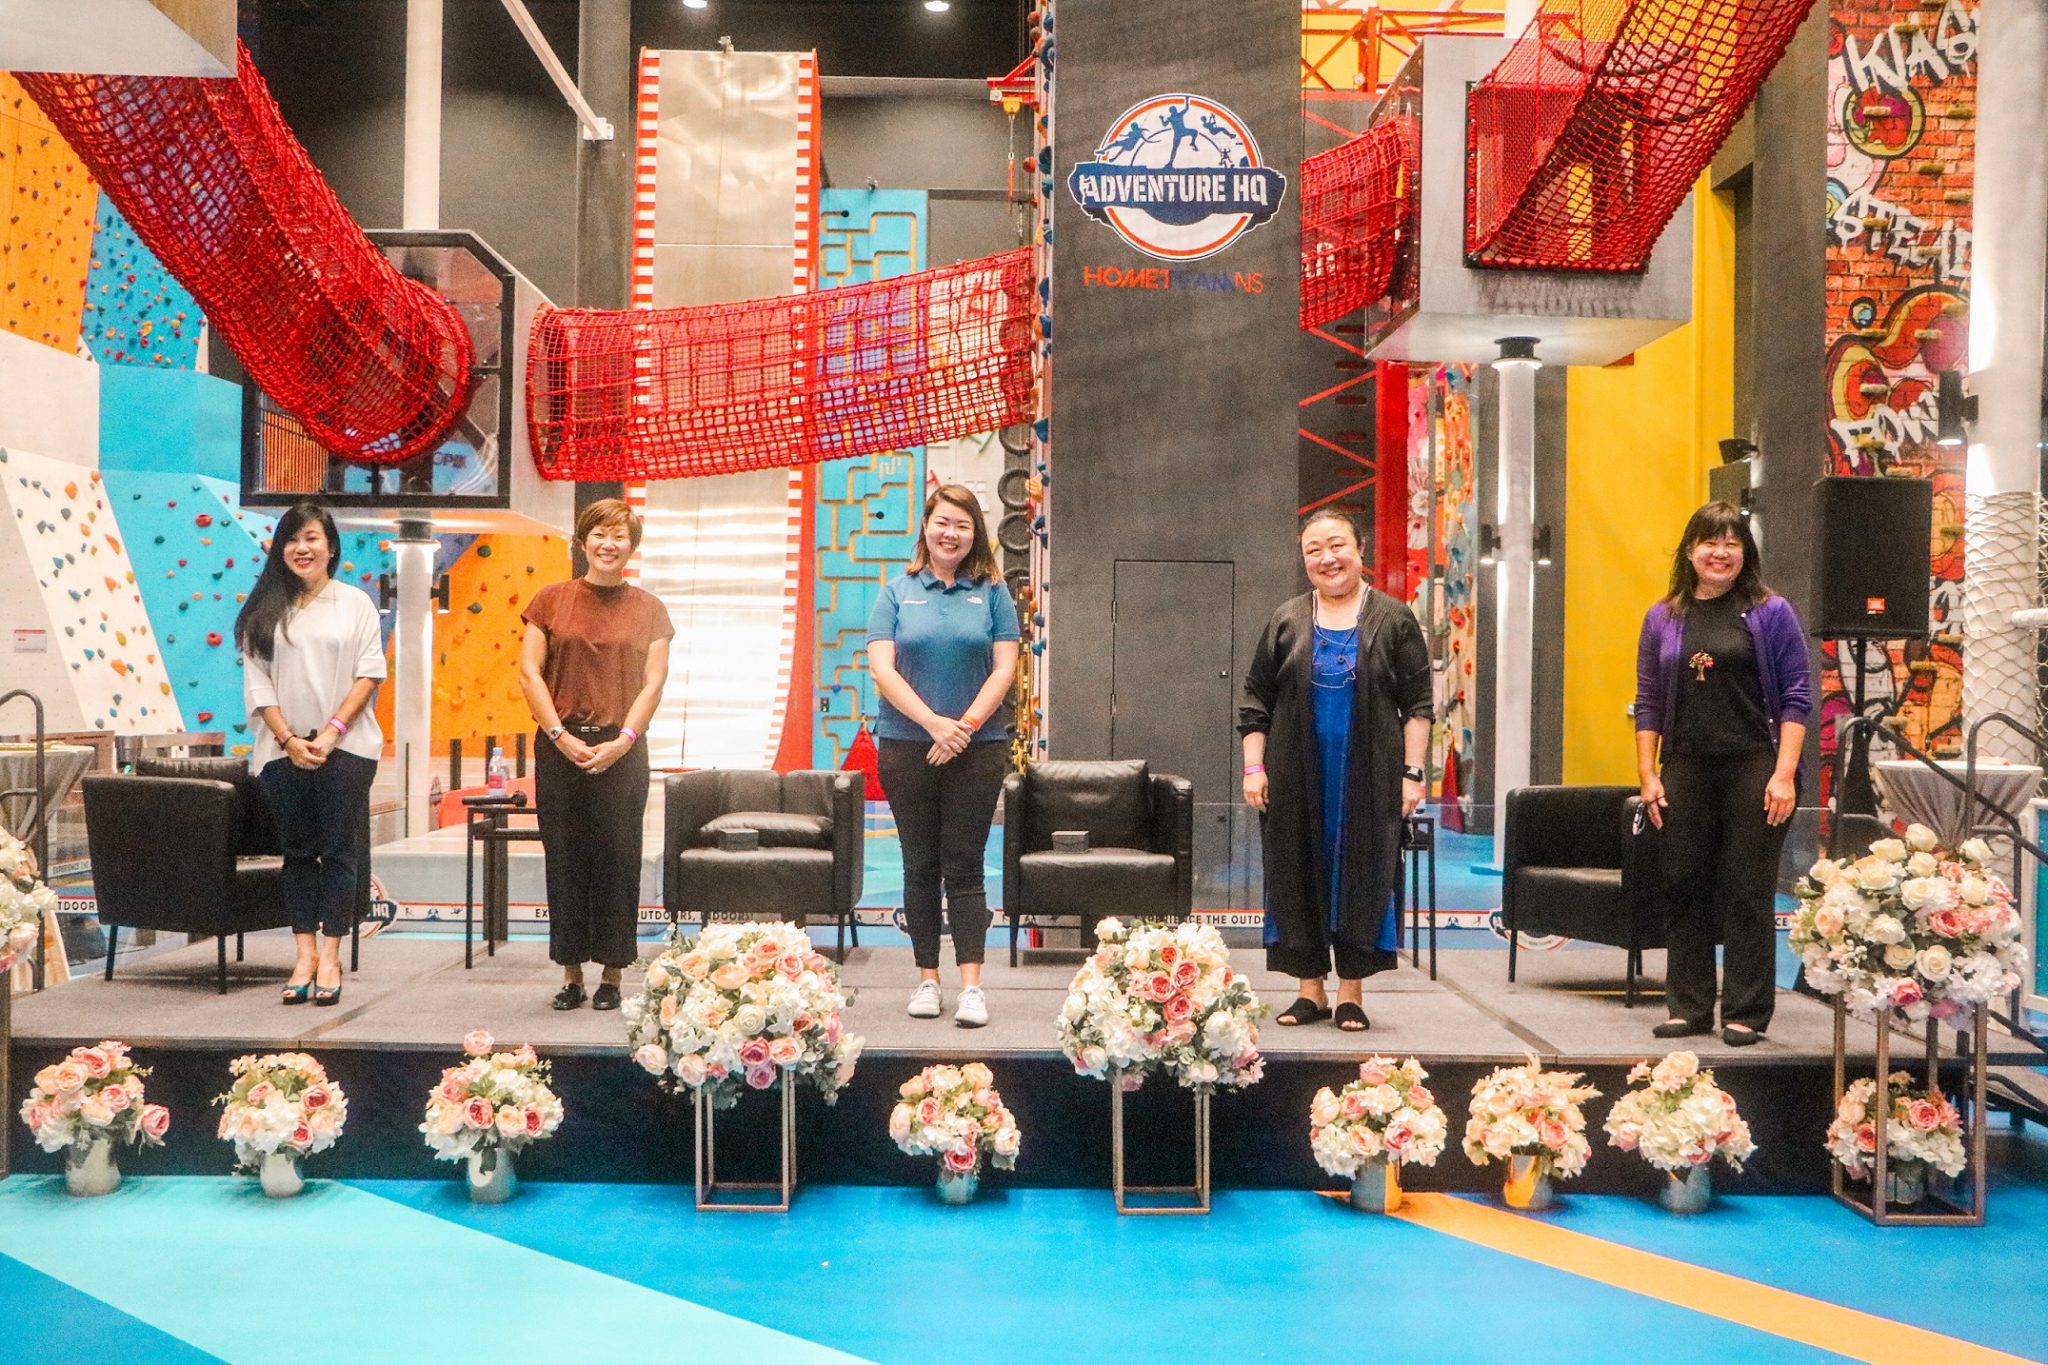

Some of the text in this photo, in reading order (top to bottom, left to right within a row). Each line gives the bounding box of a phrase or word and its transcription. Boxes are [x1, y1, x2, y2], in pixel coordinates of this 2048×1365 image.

[1080, 174, 1269, 206] ADVENTURE HQ
[372, 903, 390, 919] HQ
[1206, 914, 1227, 924] THE
